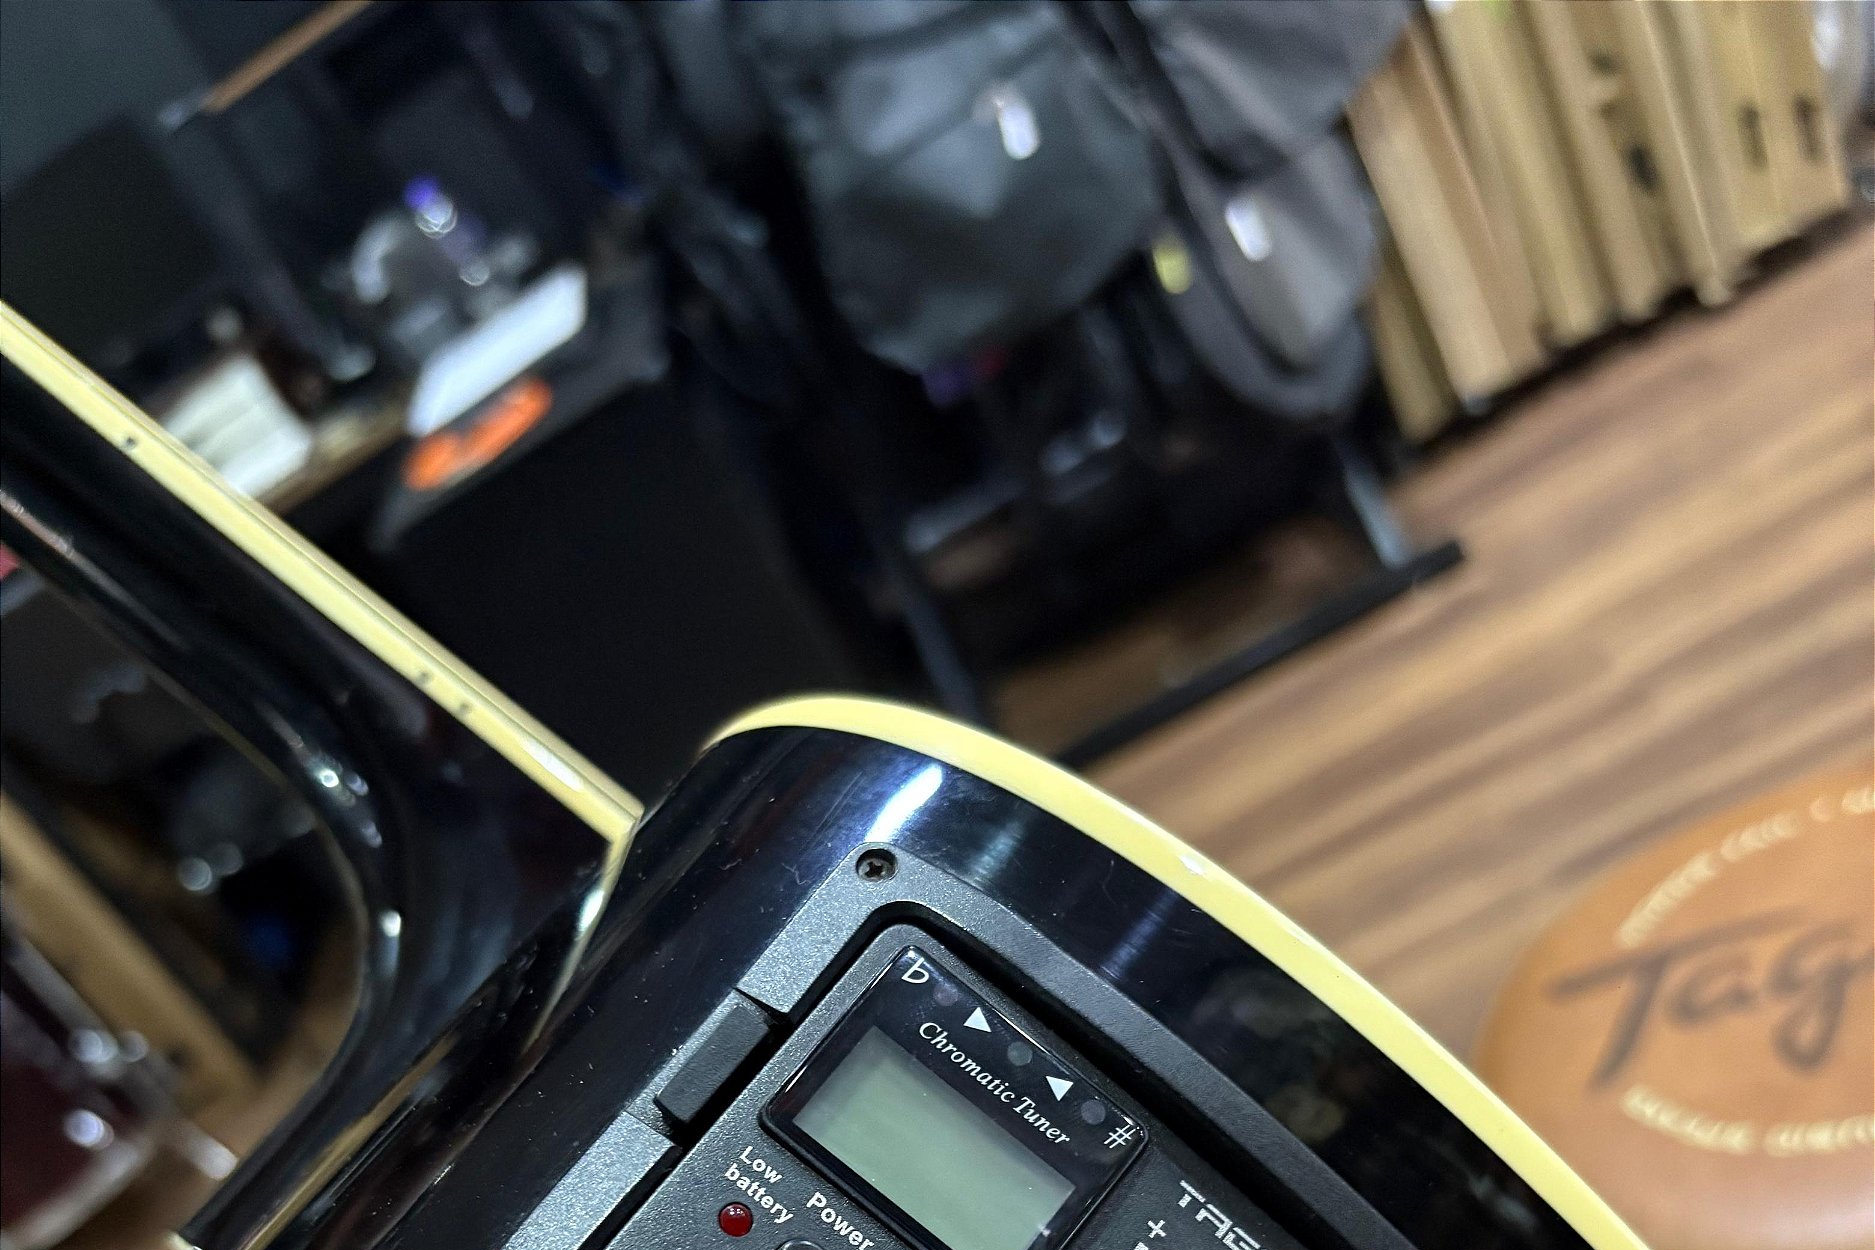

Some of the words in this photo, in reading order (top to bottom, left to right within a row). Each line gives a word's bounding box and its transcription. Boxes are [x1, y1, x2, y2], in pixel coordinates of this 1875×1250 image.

[1544, 908, 1875, 1092] Tag
[919, 1021, 1015, 1103] Chromatic
[1013, 1096, 1070, 1144] Tuner
[724, 1163, 794, 1224] battery
[739, 1145, 783, 1184] Low
[806, 1192, 875, 1250] Power
